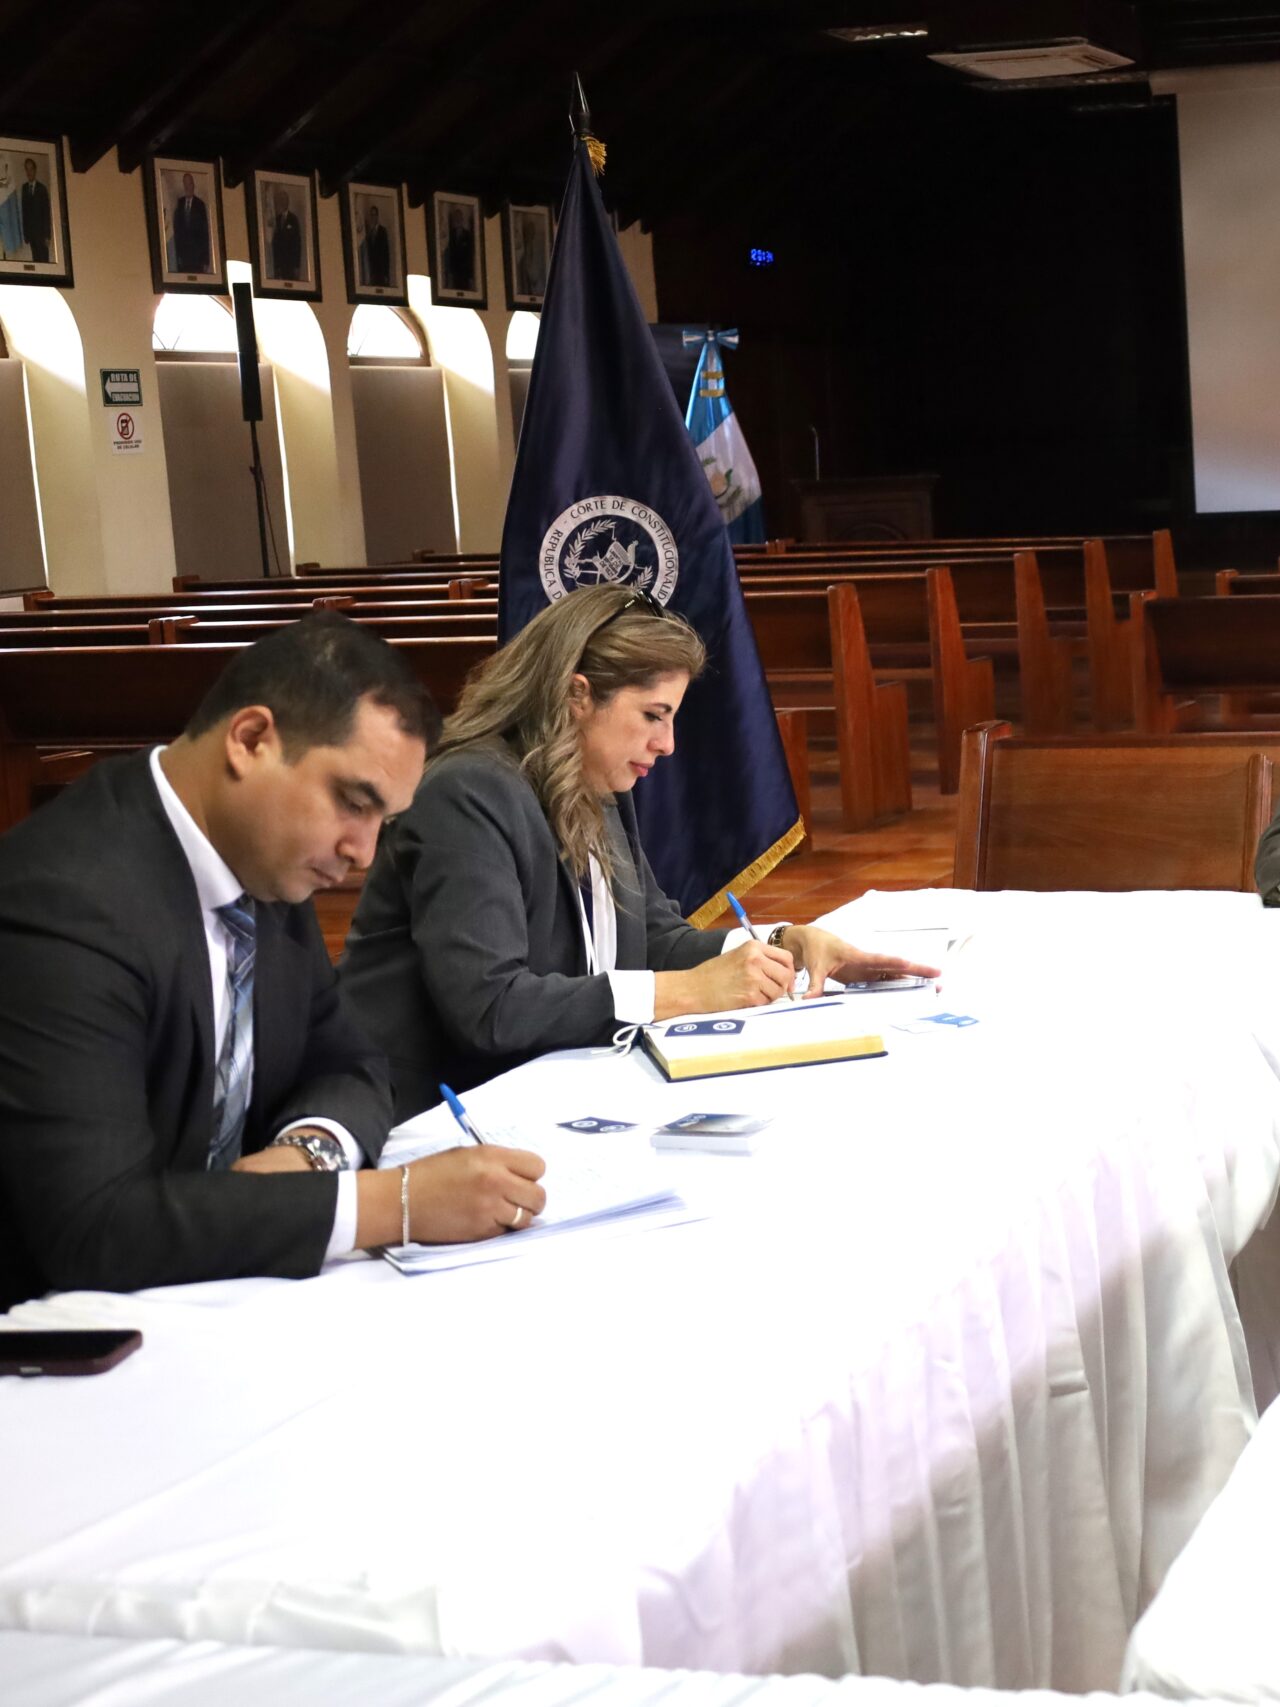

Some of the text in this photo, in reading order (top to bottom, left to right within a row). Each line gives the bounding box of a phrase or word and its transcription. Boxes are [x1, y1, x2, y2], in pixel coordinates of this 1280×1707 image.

[111, 373, 137, 382] RUTA DE
[544, 529, 564, 588] REPUBLICA
[570, 500, 607, 519] CORTE
[612, 500, 626, 511] DE
[631, 505, 675, 600] CONSTITUCIONALID
